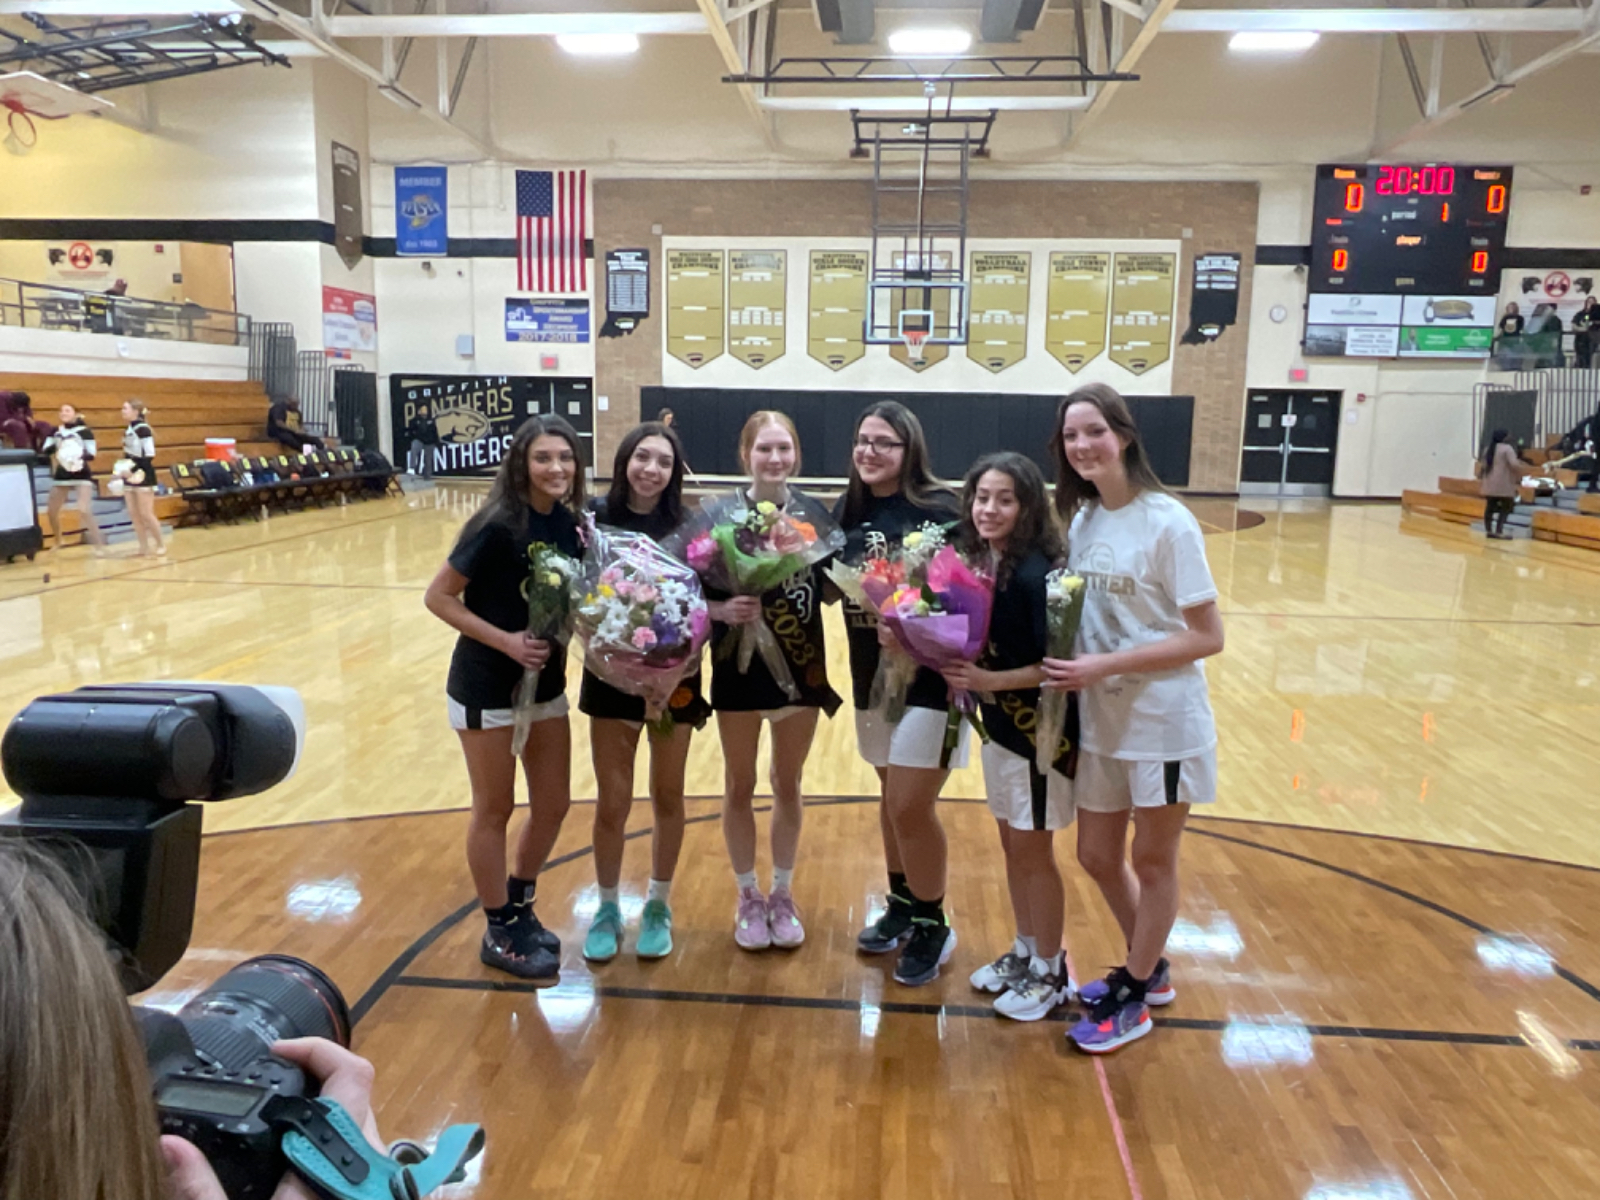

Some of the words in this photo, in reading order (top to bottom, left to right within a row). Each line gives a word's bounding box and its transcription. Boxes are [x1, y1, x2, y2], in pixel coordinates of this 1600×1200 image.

[1375, 165, 1455, 196] 20:00
[1344, 183, 1365, 212] 0
[1486, 184, 1506, 213] 0
[1440, 202, 1450, 223] 1
[1332, 249, 1348, 272] 0
[1472, 251, 1488, 274] 0
[407, 376, 508, 400] GRIFFITH
[404, 386, 513, 428] PNTHERS
[406, 435, 515, 476] NTHERS
[764, 598, 815, 666] 2023
